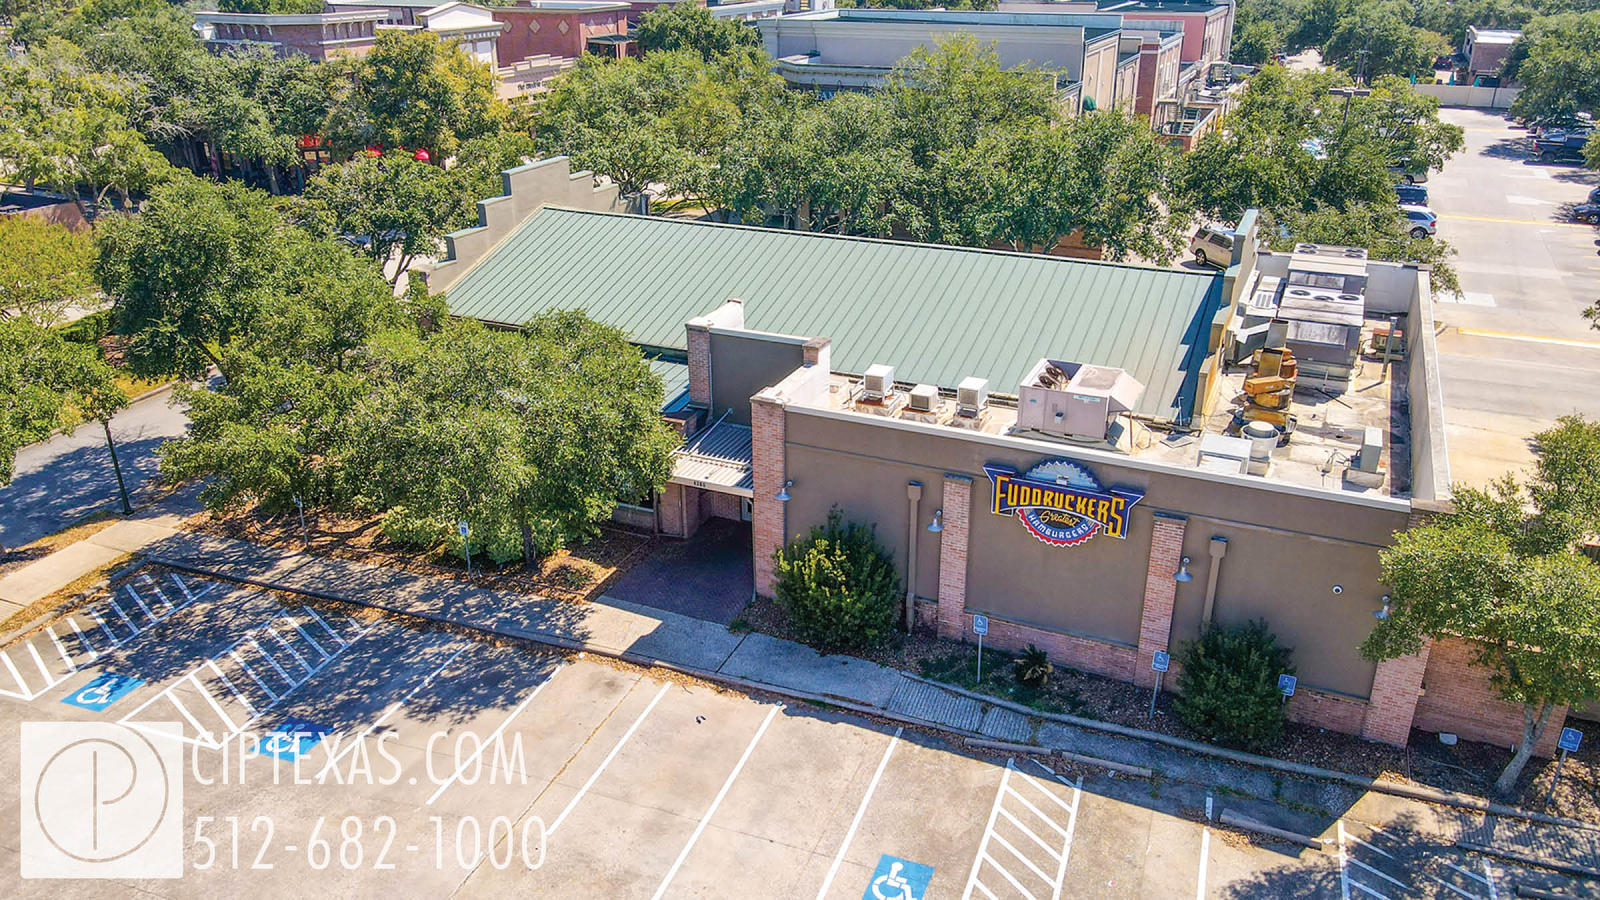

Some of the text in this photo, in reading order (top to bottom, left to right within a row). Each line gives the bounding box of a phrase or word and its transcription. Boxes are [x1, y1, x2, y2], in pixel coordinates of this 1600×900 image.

[995, 475, 1126, 537] FUDDRUCKERS
[1039, 509, 1081, 528] Greatest
[1028, 514, 1089, 540] HAMBURGERS
